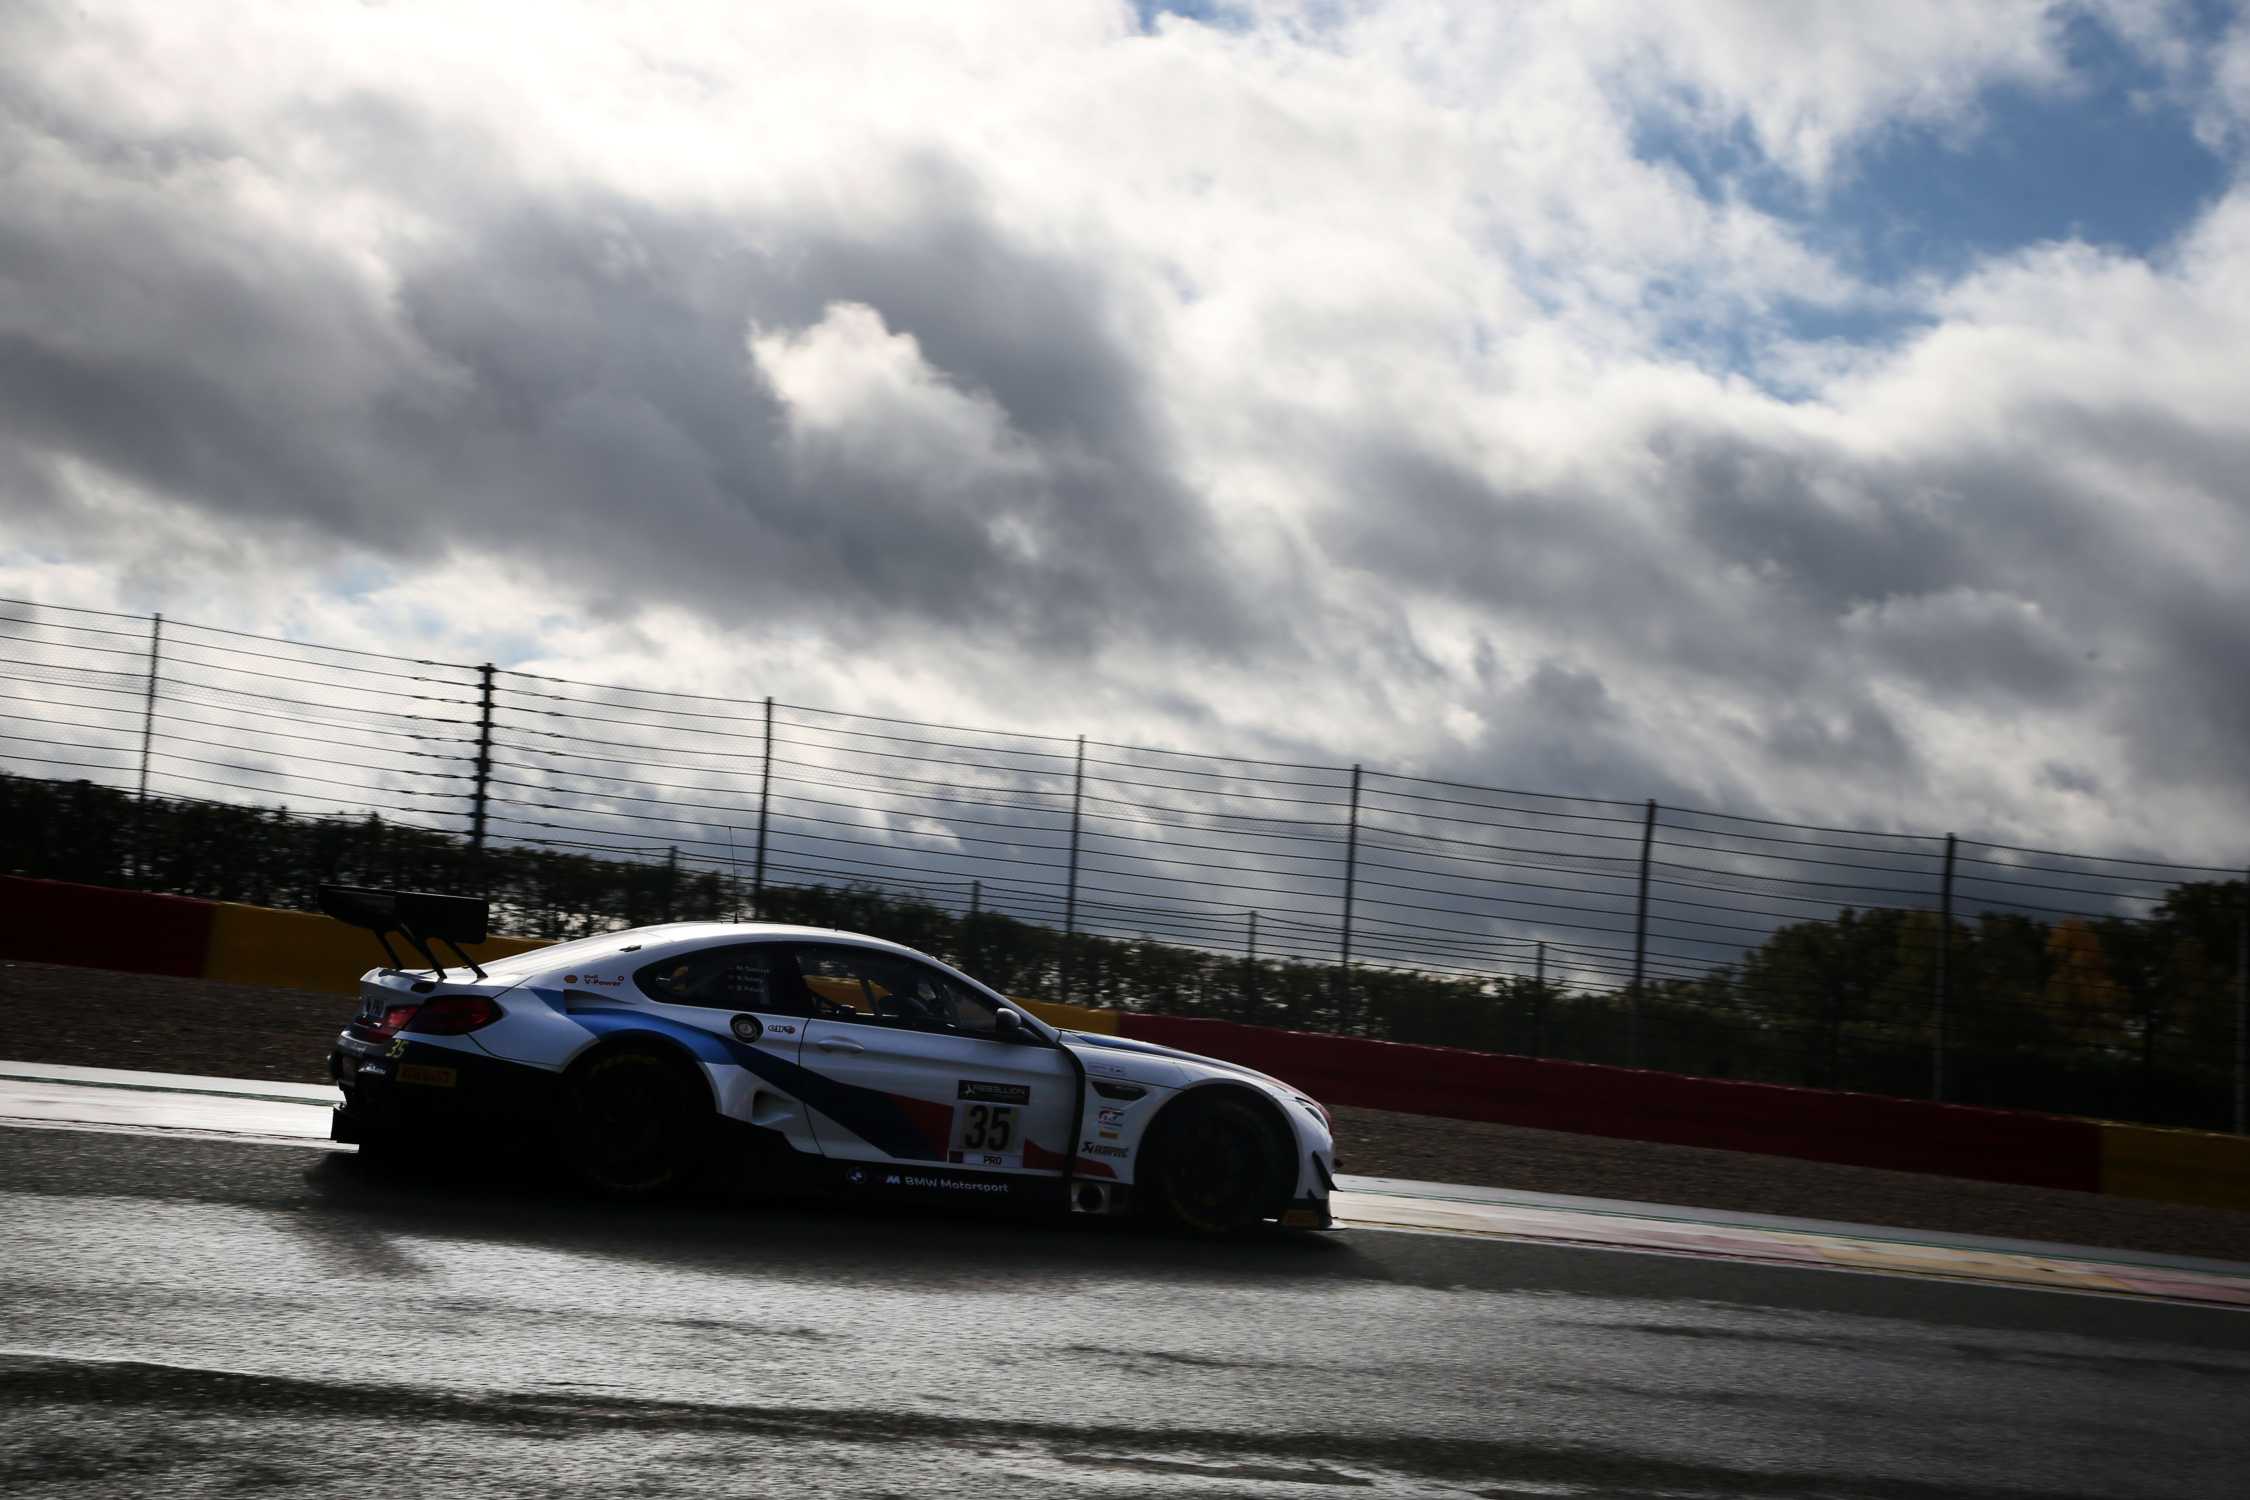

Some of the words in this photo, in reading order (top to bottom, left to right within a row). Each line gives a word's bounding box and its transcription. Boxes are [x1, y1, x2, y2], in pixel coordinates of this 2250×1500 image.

[385, 1039, 409, 1058] 35
[965, 1105, 1011, 1151] 35
[983, 1154, 1002, 1165] PRO
[904, 1176, 938, 1187] BMW
[940, 1178, 1009, 1193] Motorsport
